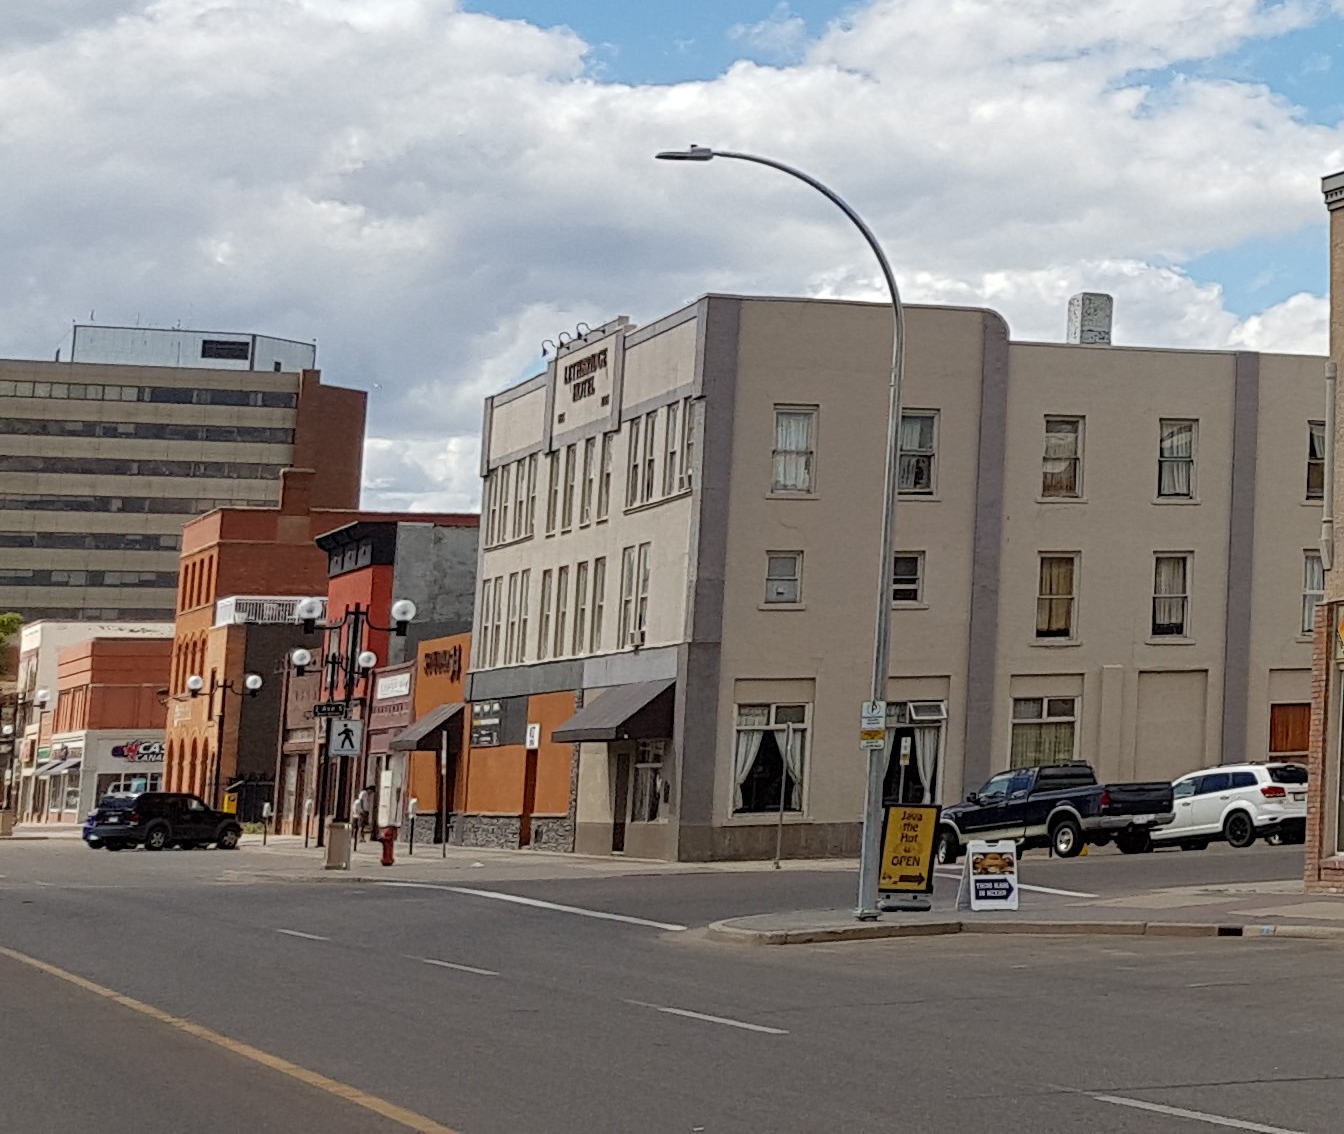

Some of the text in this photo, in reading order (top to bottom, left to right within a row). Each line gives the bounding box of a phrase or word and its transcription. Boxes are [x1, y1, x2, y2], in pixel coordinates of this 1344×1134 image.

[572, 375, 596, 403] HOTEL
[900, 810, 923, 821] Java
[891, 855, 921, 867] OPEN
